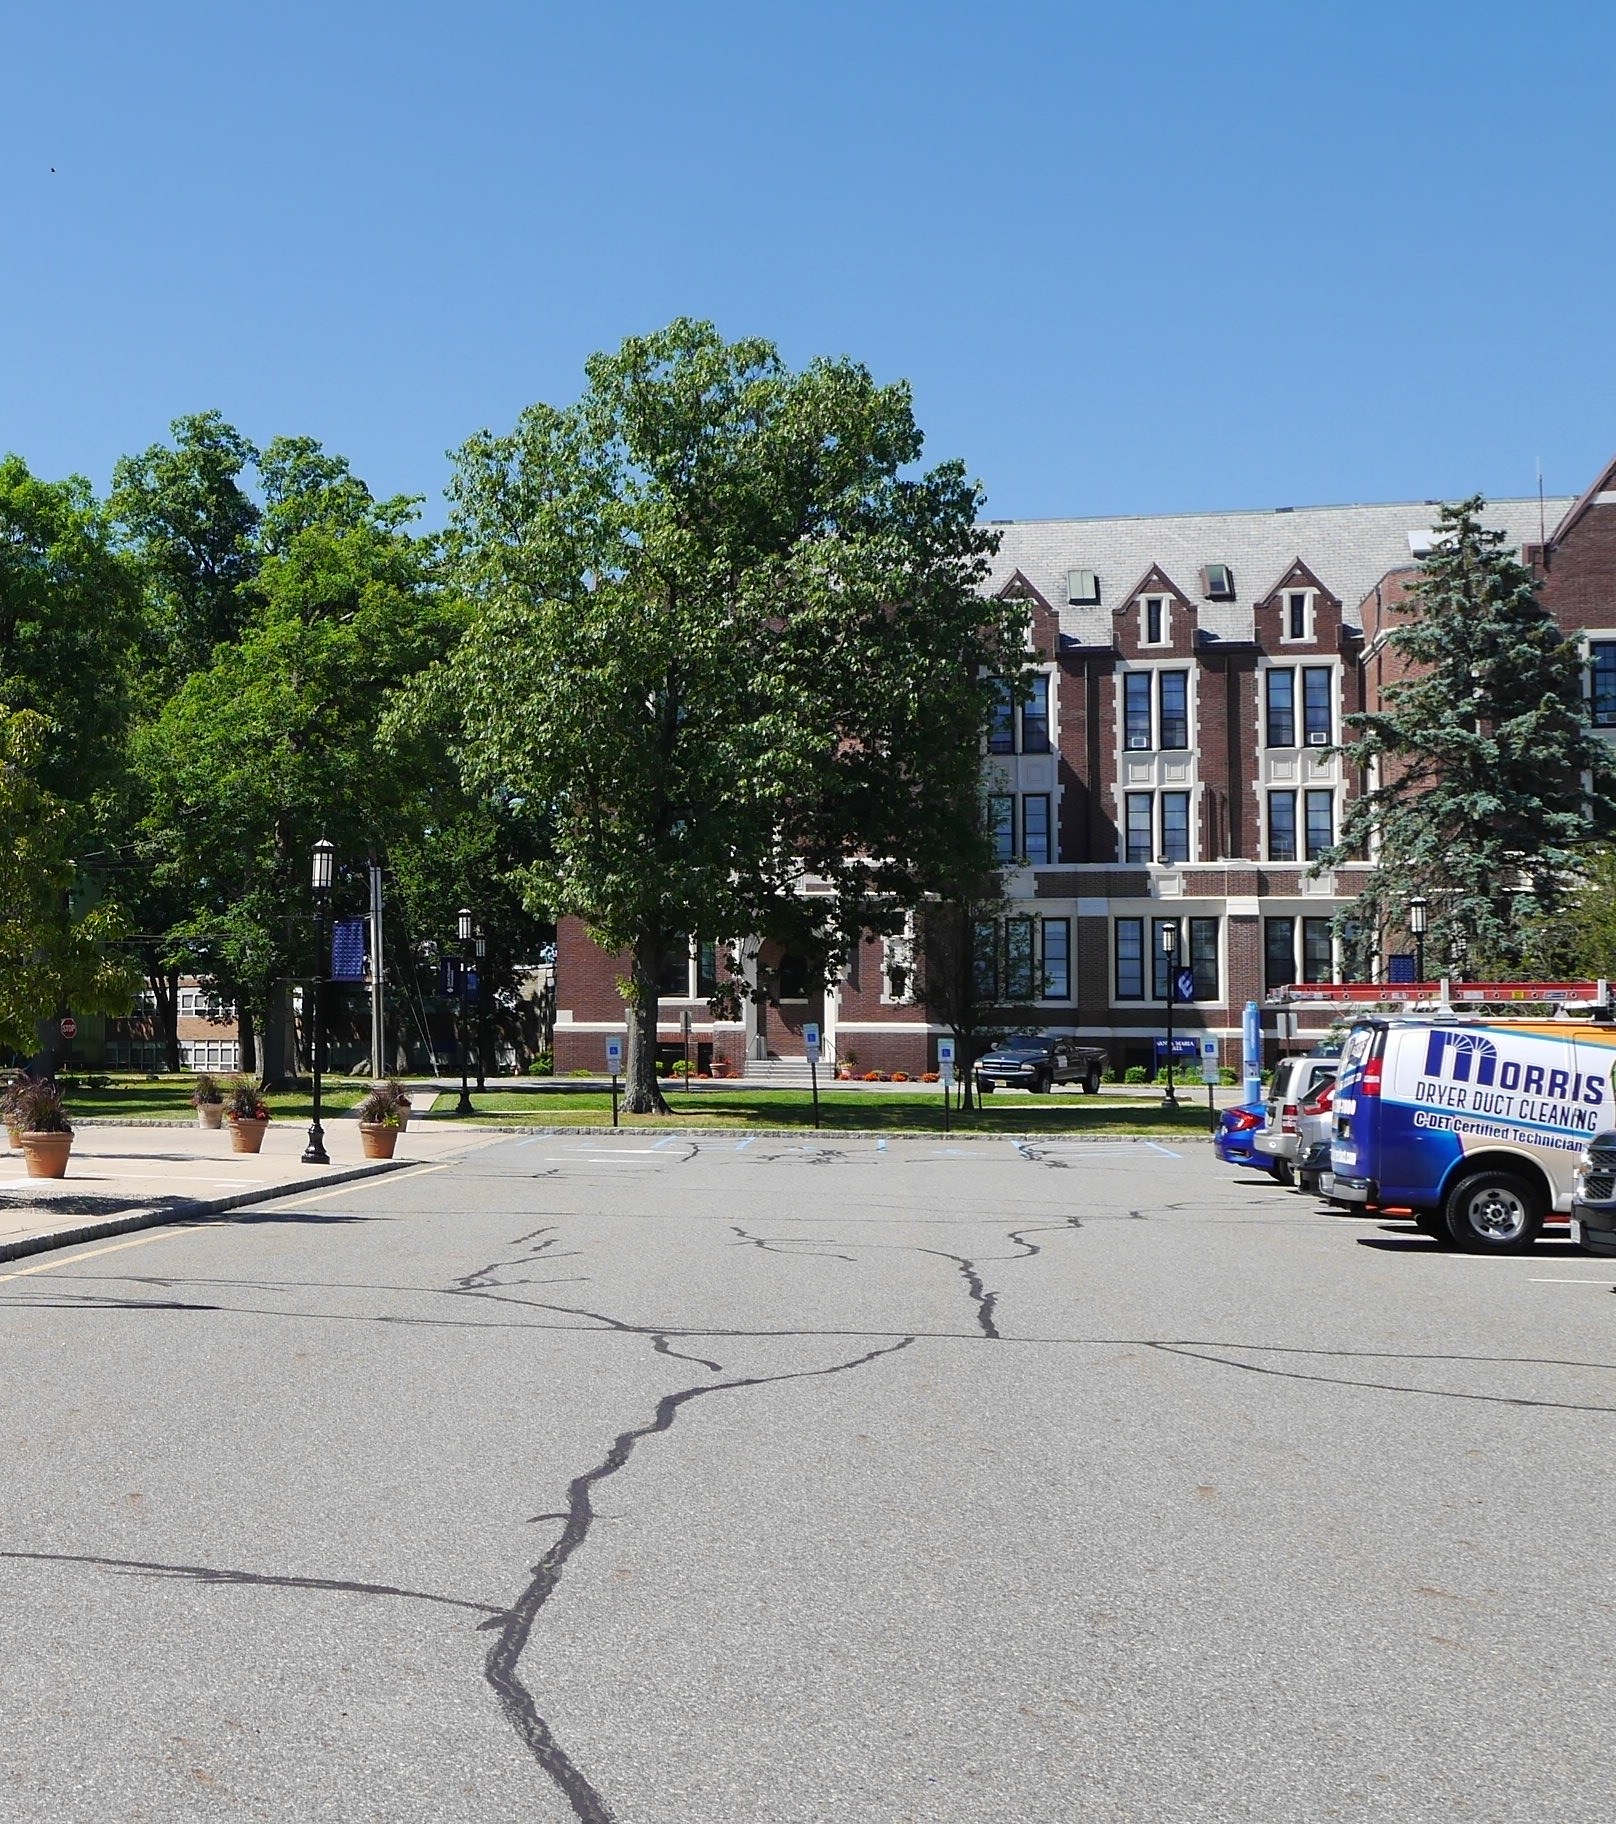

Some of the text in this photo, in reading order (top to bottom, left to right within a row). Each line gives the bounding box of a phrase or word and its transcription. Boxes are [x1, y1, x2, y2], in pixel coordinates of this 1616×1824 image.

[1424, 1030, 1606, 1105] MORRIS
[1415, 1081, 1598, 1132] DRYER DUCT CLEANING
[1415, 1112, 1583, 1152] C-DET Certified Technician
